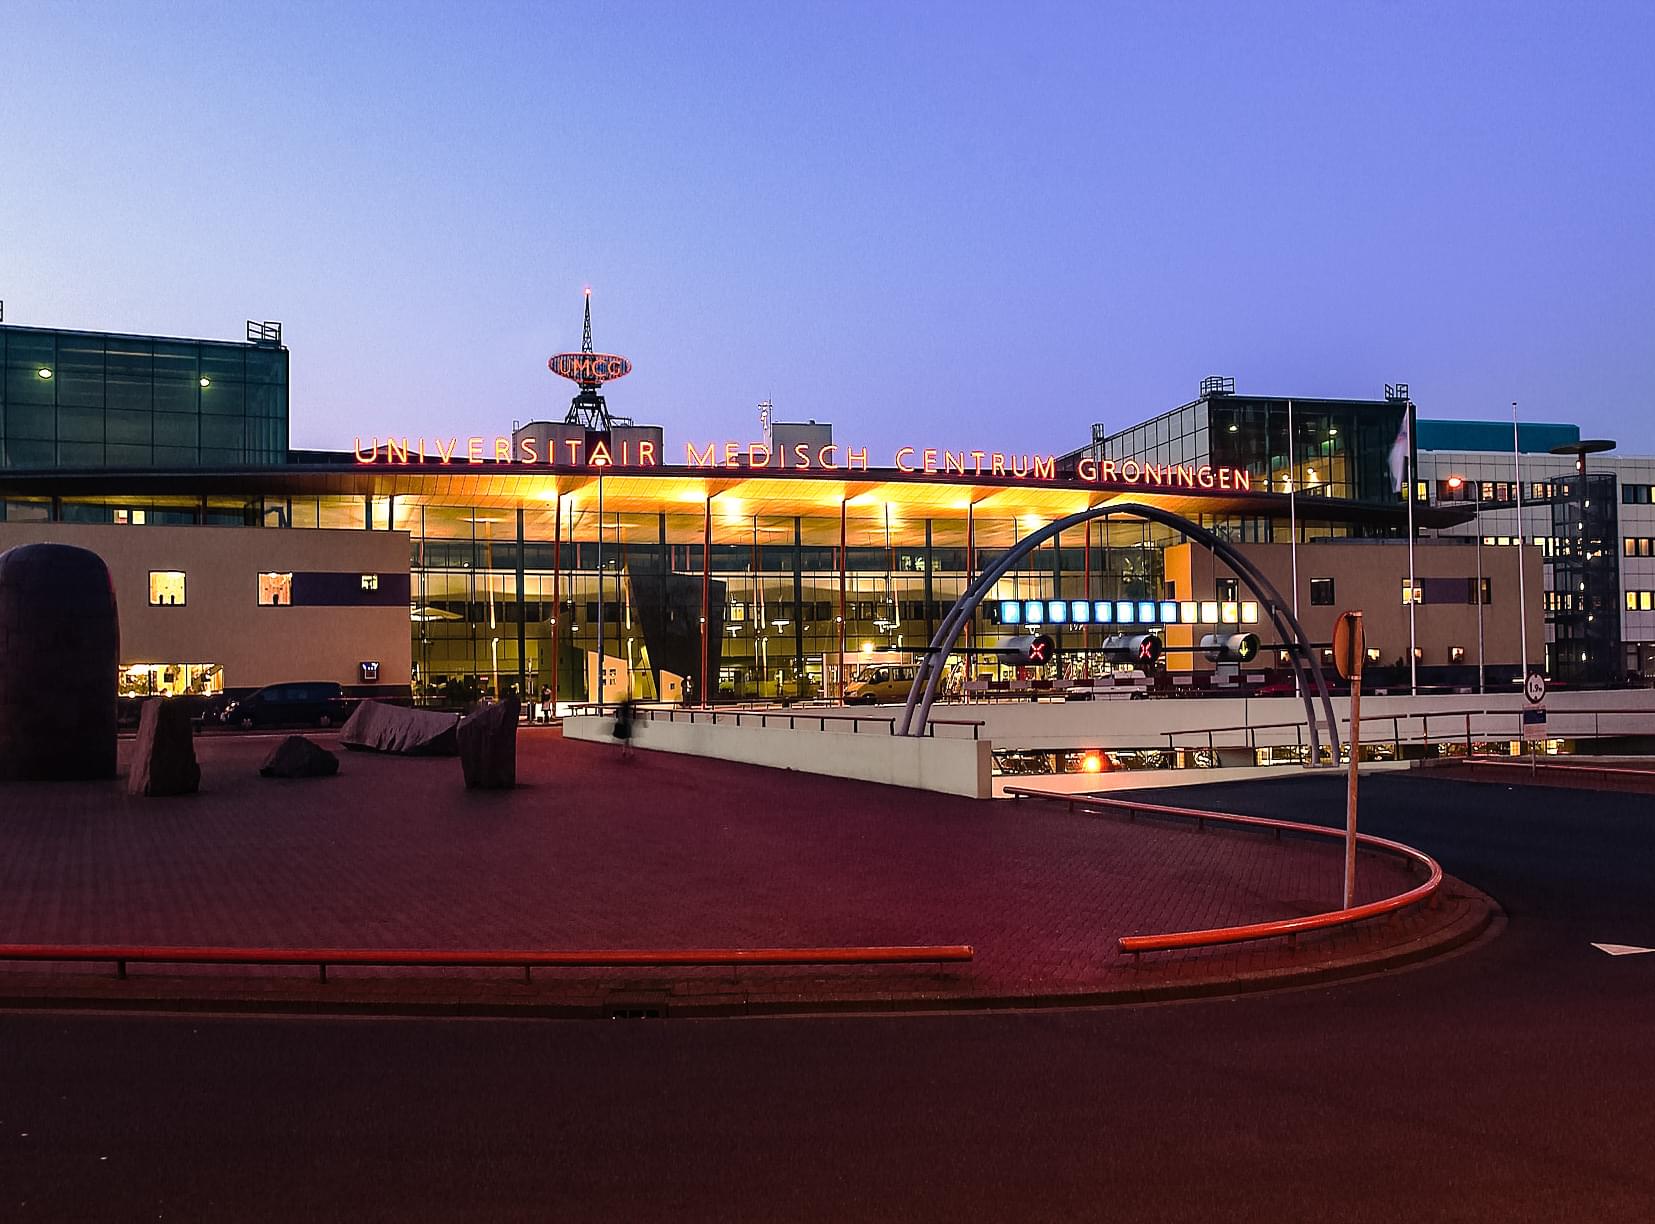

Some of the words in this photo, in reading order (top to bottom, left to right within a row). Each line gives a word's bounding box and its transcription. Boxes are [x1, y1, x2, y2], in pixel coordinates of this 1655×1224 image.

[559, 358, 621, 377] UMCG
[354, 437, 658, 467] UNIVERSITAIR
[686, 440, 868, 471] MEDISCH
[894, 446, 1056, 480] CENTRUM
[1078, 458, 1251, 492] GRONINGEN
